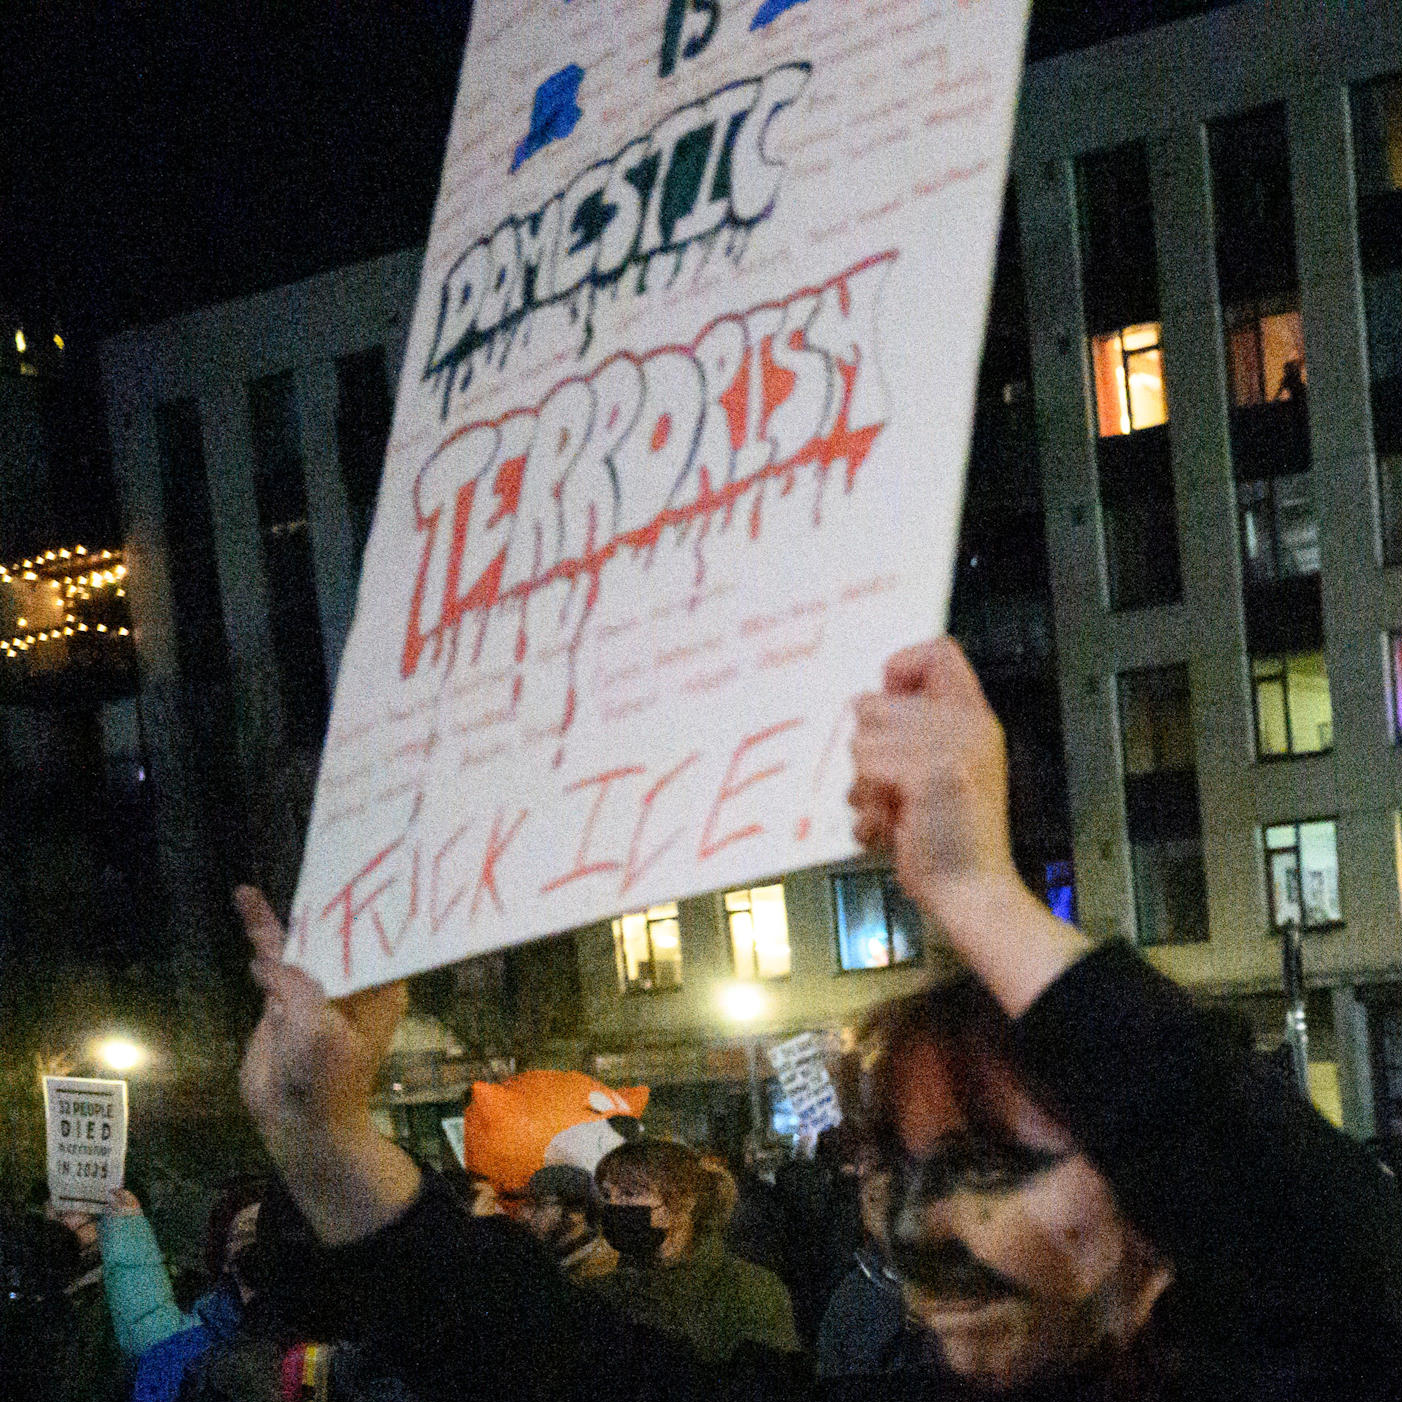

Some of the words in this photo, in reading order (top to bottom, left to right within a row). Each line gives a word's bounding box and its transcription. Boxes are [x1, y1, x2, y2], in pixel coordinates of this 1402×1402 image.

[420, 60, 812, 384] DOMESTIC
[401, 249, 898, 678] TERRORIST
[60, 1119, 112, 1141] DIED
[73, 1101, 114, 1119] PEOPLE
